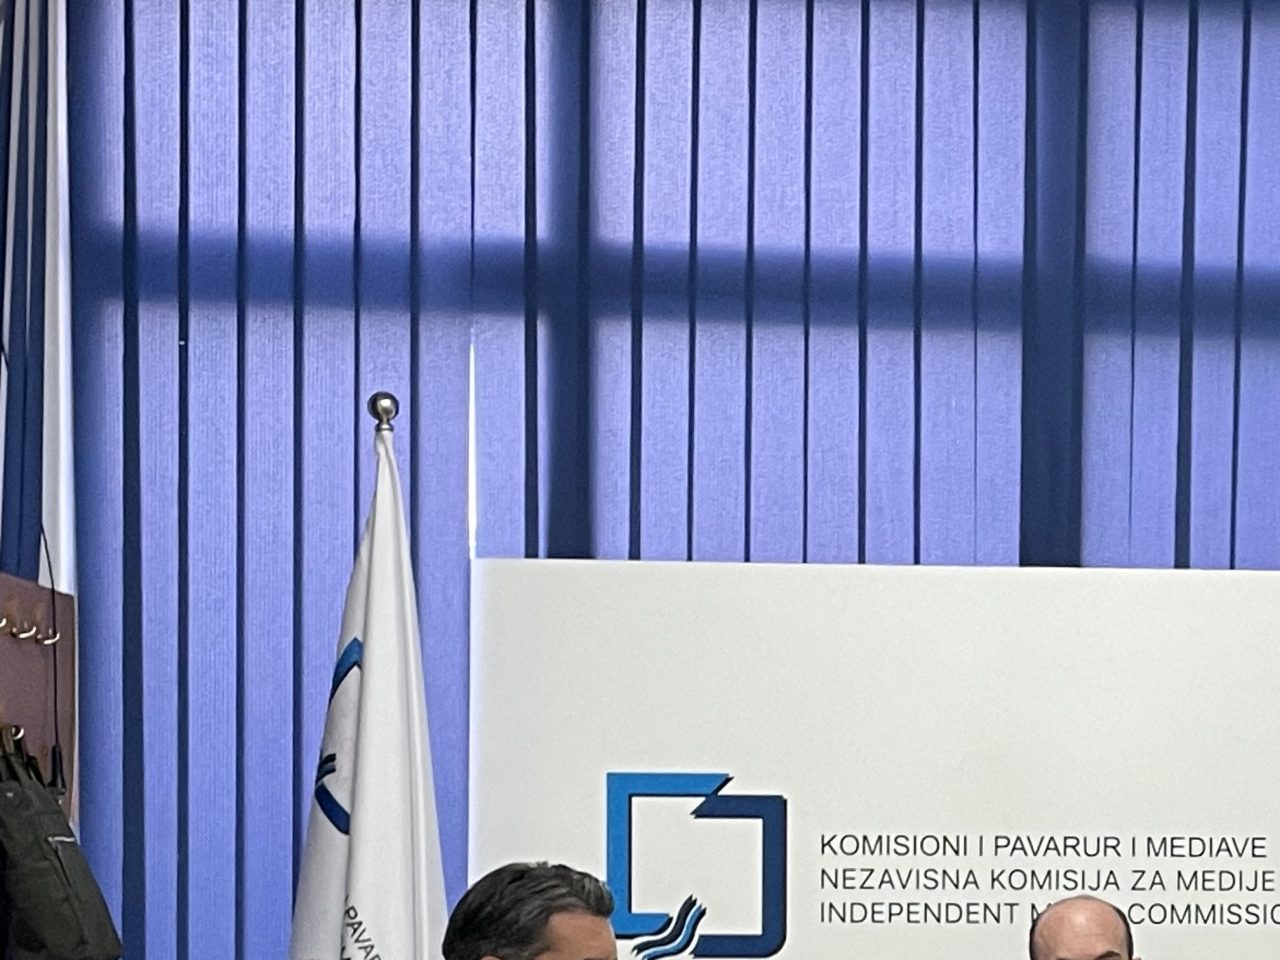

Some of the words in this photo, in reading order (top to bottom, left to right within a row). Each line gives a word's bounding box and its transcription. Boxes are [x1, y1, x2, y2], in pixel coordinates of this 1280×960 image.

[820, 834, 968, 857] KOMISIONI
[978, 835, 984, 857] I
[993, 836, 1122, 857] PAVARUR
[1131, 837, 1136, 857] I
[1146, 837, 1268, 858] MEDIAVE
[820, 868, 980, 890] NEZAVISNA
[990, 869, 1121, 891] KOMISIJA
[1131, 870, 1166, 891] ZA
[1176, 870, 1276, 892] MEDIJE
[820, 902, 1020, 924] INDEPENDENT
